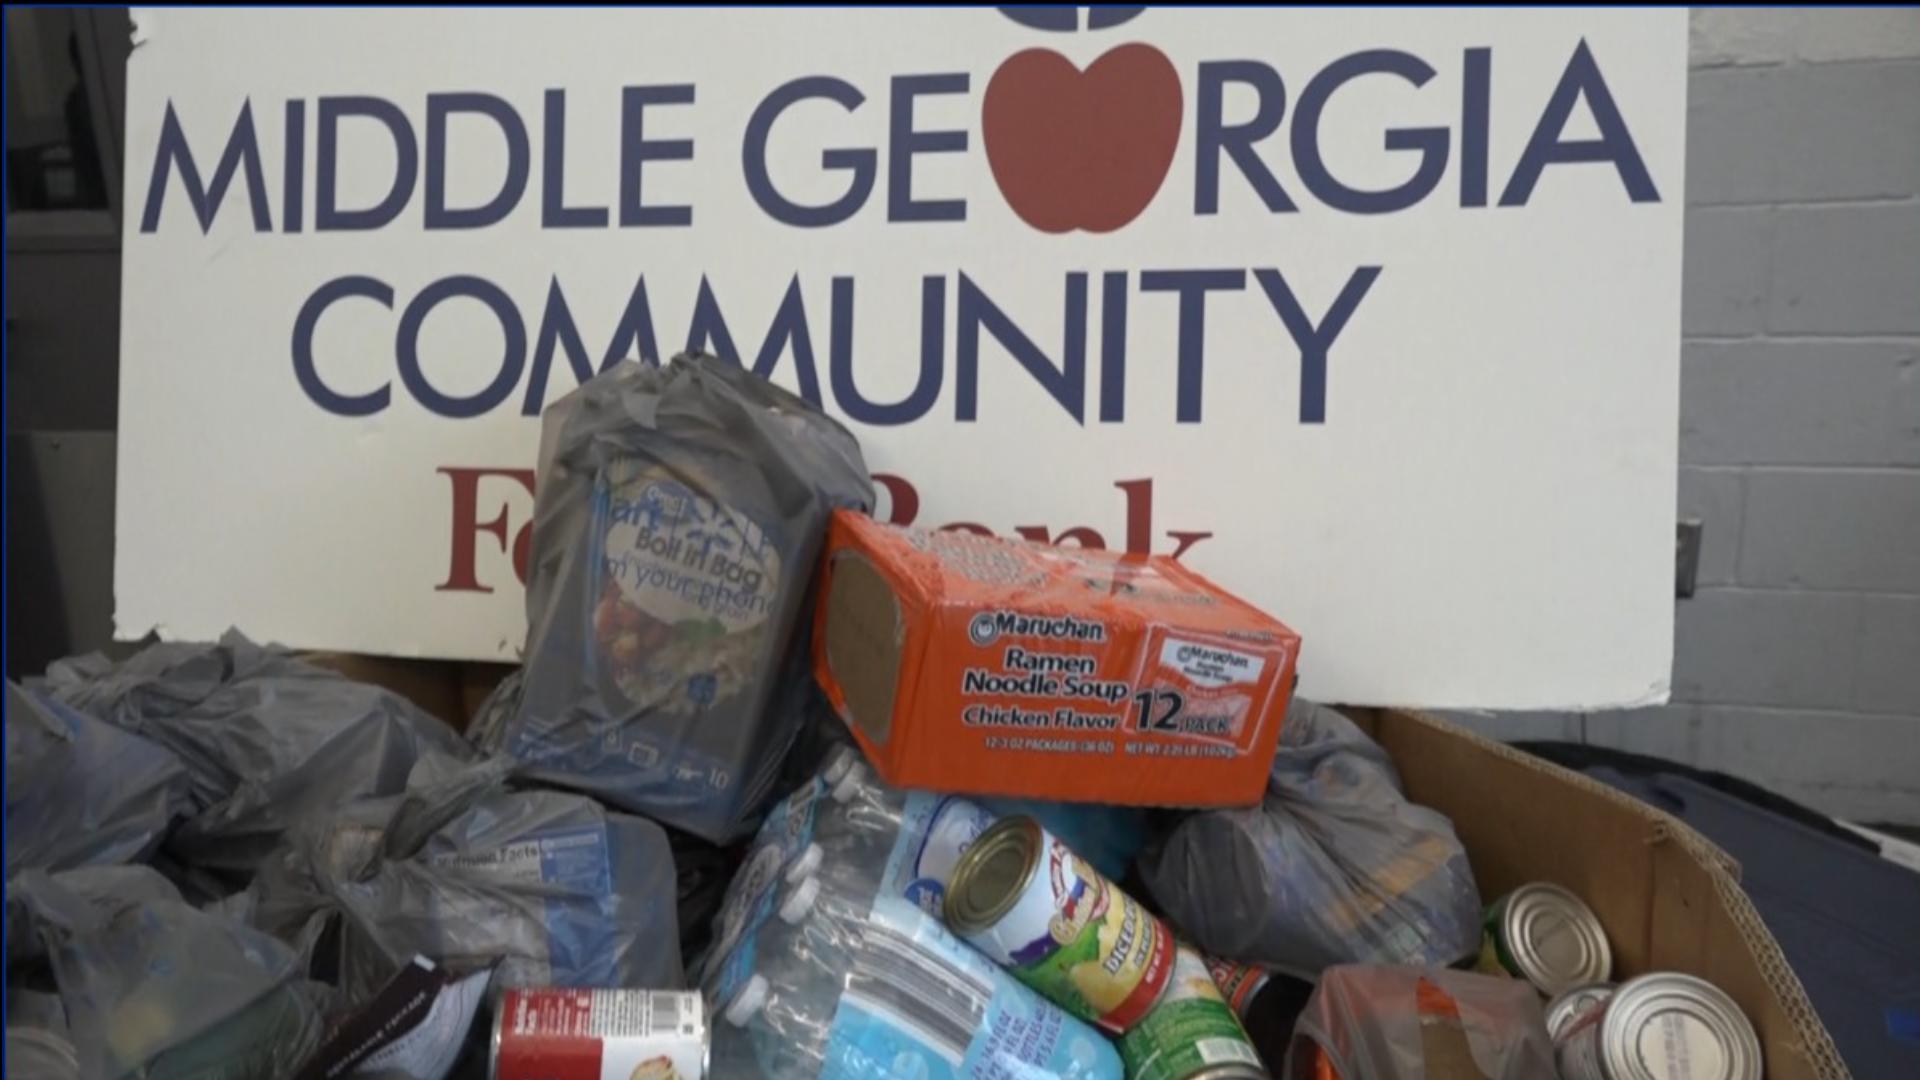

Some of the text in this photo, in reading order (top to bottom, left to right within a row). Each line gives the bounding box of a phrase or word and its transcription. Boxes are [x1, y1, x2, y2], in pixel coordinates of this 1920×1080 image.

[139, 83, 696, 236] MIDDLE
[291, 265, 1384, 427] COMMUNITY
[996, 612, 1104, 641] Maruchan
[1005, 648, 1096, 674] Ramen
[1191, 646, 1249, 668] Maruchan
[964, 670, 1128, 703] Noodle Soup
[963, 705, 1120, 730] Chicken Flavor
[1135, 690, 1183, 730] 12
[1184, 716, 1231, 733] PACK
